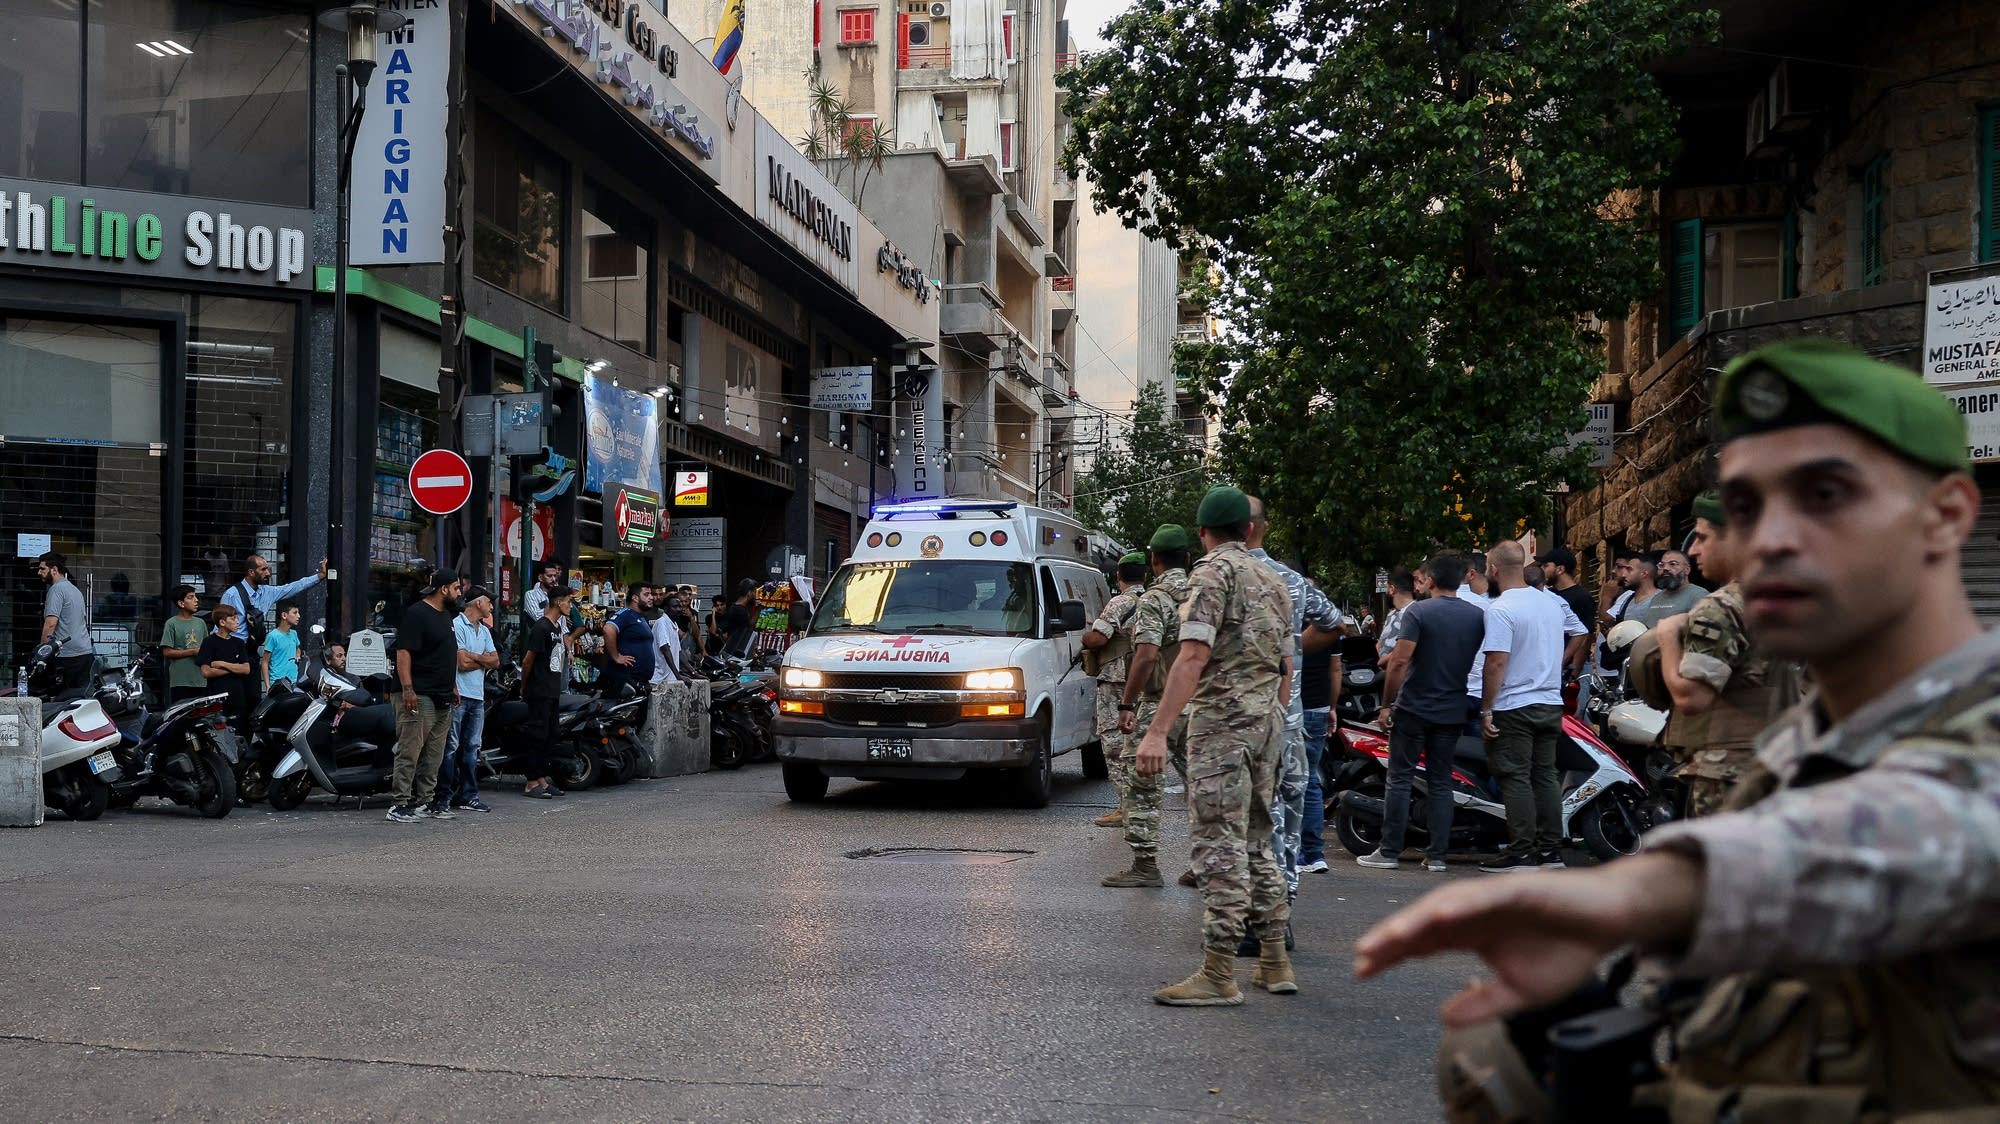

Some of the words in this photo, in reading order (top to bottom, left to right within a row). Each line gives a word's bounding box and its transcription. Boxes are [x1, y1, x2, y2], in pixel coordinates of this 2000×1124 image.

[768, 155, 851, 262] MARIGNAN
[185, 209, 305, 282] Shop
[1935, 360, 1987, 374] GENERAL
[817, 393, 868, 402] MARIGNAN
[910, 399, 927, 492] WEEKEND
[630, 507, 655, 527] market
[682, 528, 720, 537] CENTER
